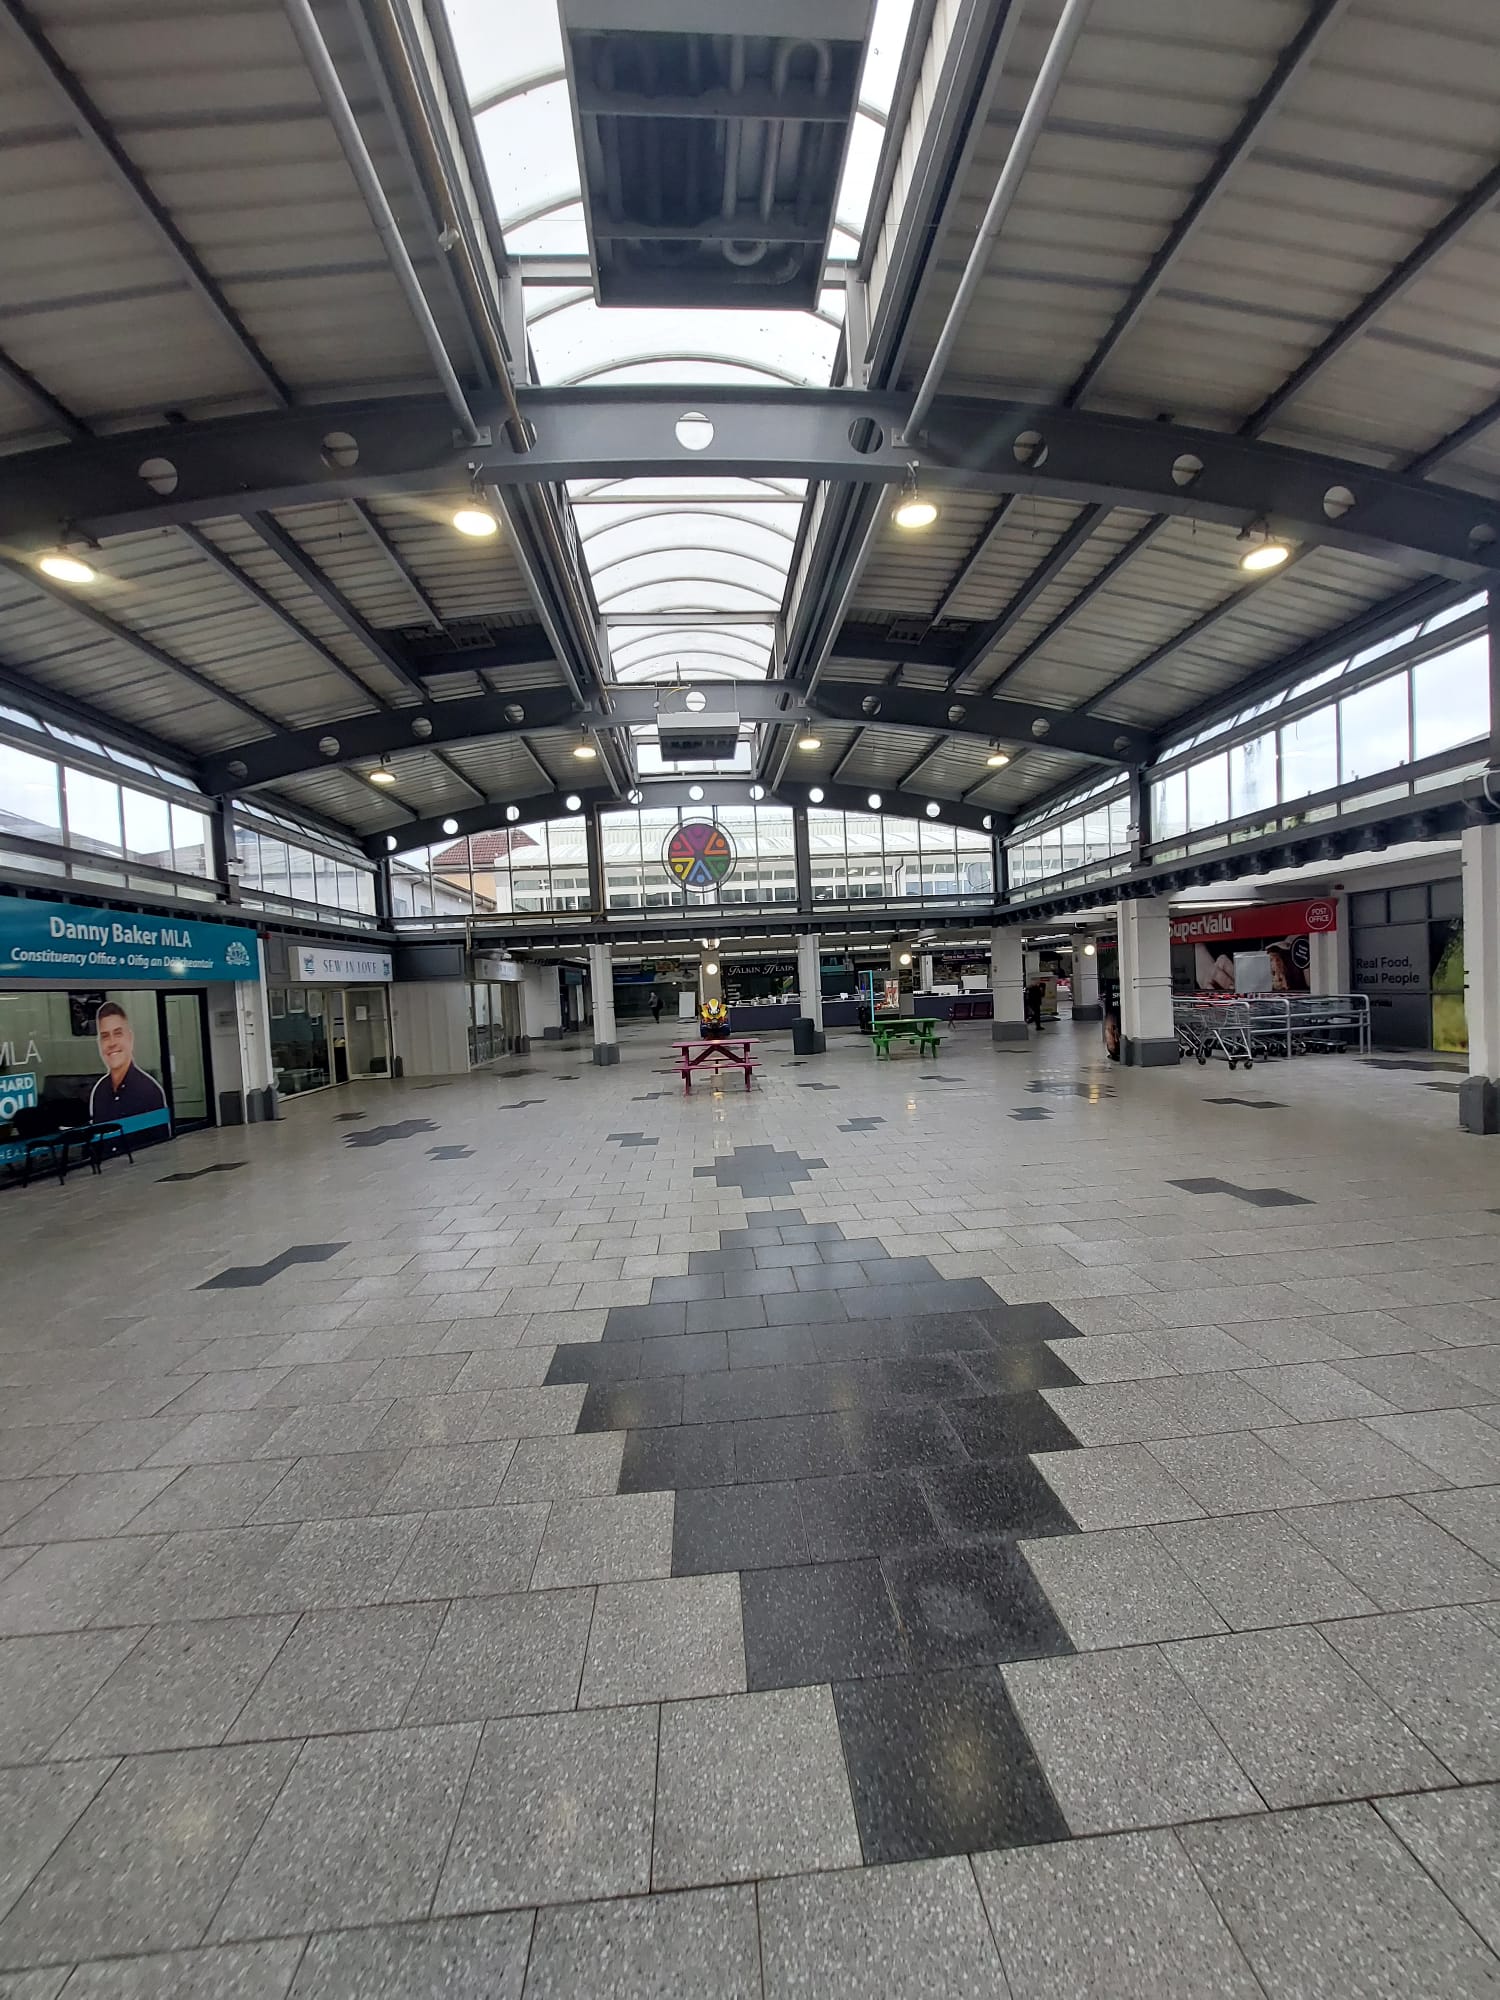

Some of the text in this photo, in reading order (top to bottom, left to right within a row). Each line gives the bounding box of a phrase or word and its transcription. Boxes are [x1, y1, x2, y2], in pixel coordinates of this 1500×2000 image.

[1308, 914, 1329, 923] OFFICE
[1311, 907, 1327, 916] POST
[50, 916, 192, 948] Danny Baker MLA
[1169, 912, 1233, 943] SuperValu
[10, 947, 86, 967] Constituency
[88, 952, 117, 966] Office
[1357, 956, 1412, 969] Real Food,
[323, 959, 377, 974] SEW IN LOVE
[1357, 972, 1420, 986] Real People
